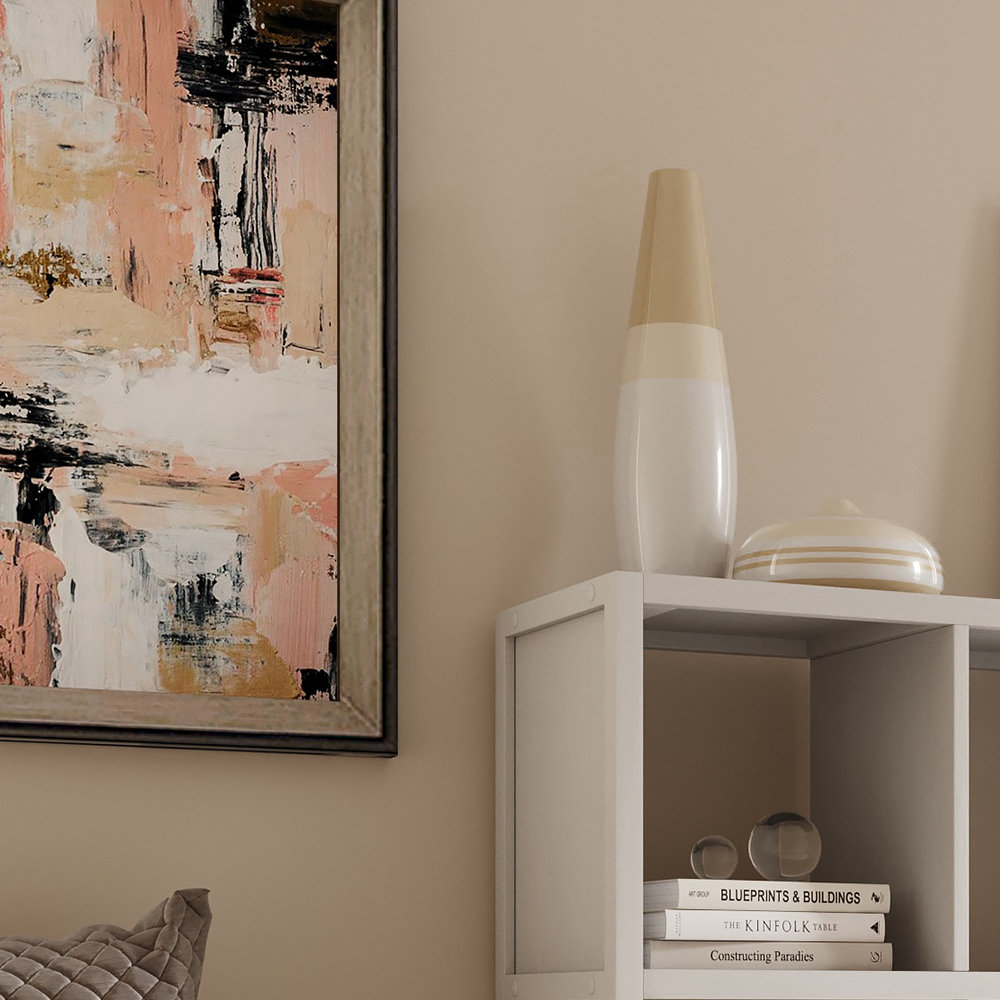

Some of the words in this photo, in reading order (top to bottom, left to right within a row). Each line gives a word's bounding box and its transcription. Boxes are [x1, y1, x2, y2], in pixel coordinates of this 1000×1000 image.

[720, 888, 790, 903] BLUEPRINTS
[792, 890, 801, 903] &
[803, 891, 861, 905] BUILDINGS
[723, 921, 741, 929] THE
[745, 919, 811, 933] KINFOLK
[812, 923, 838, 931] TABLE
[710, 950, 772, 964] Constructing
[774, 950, 814, 962] Paradies
